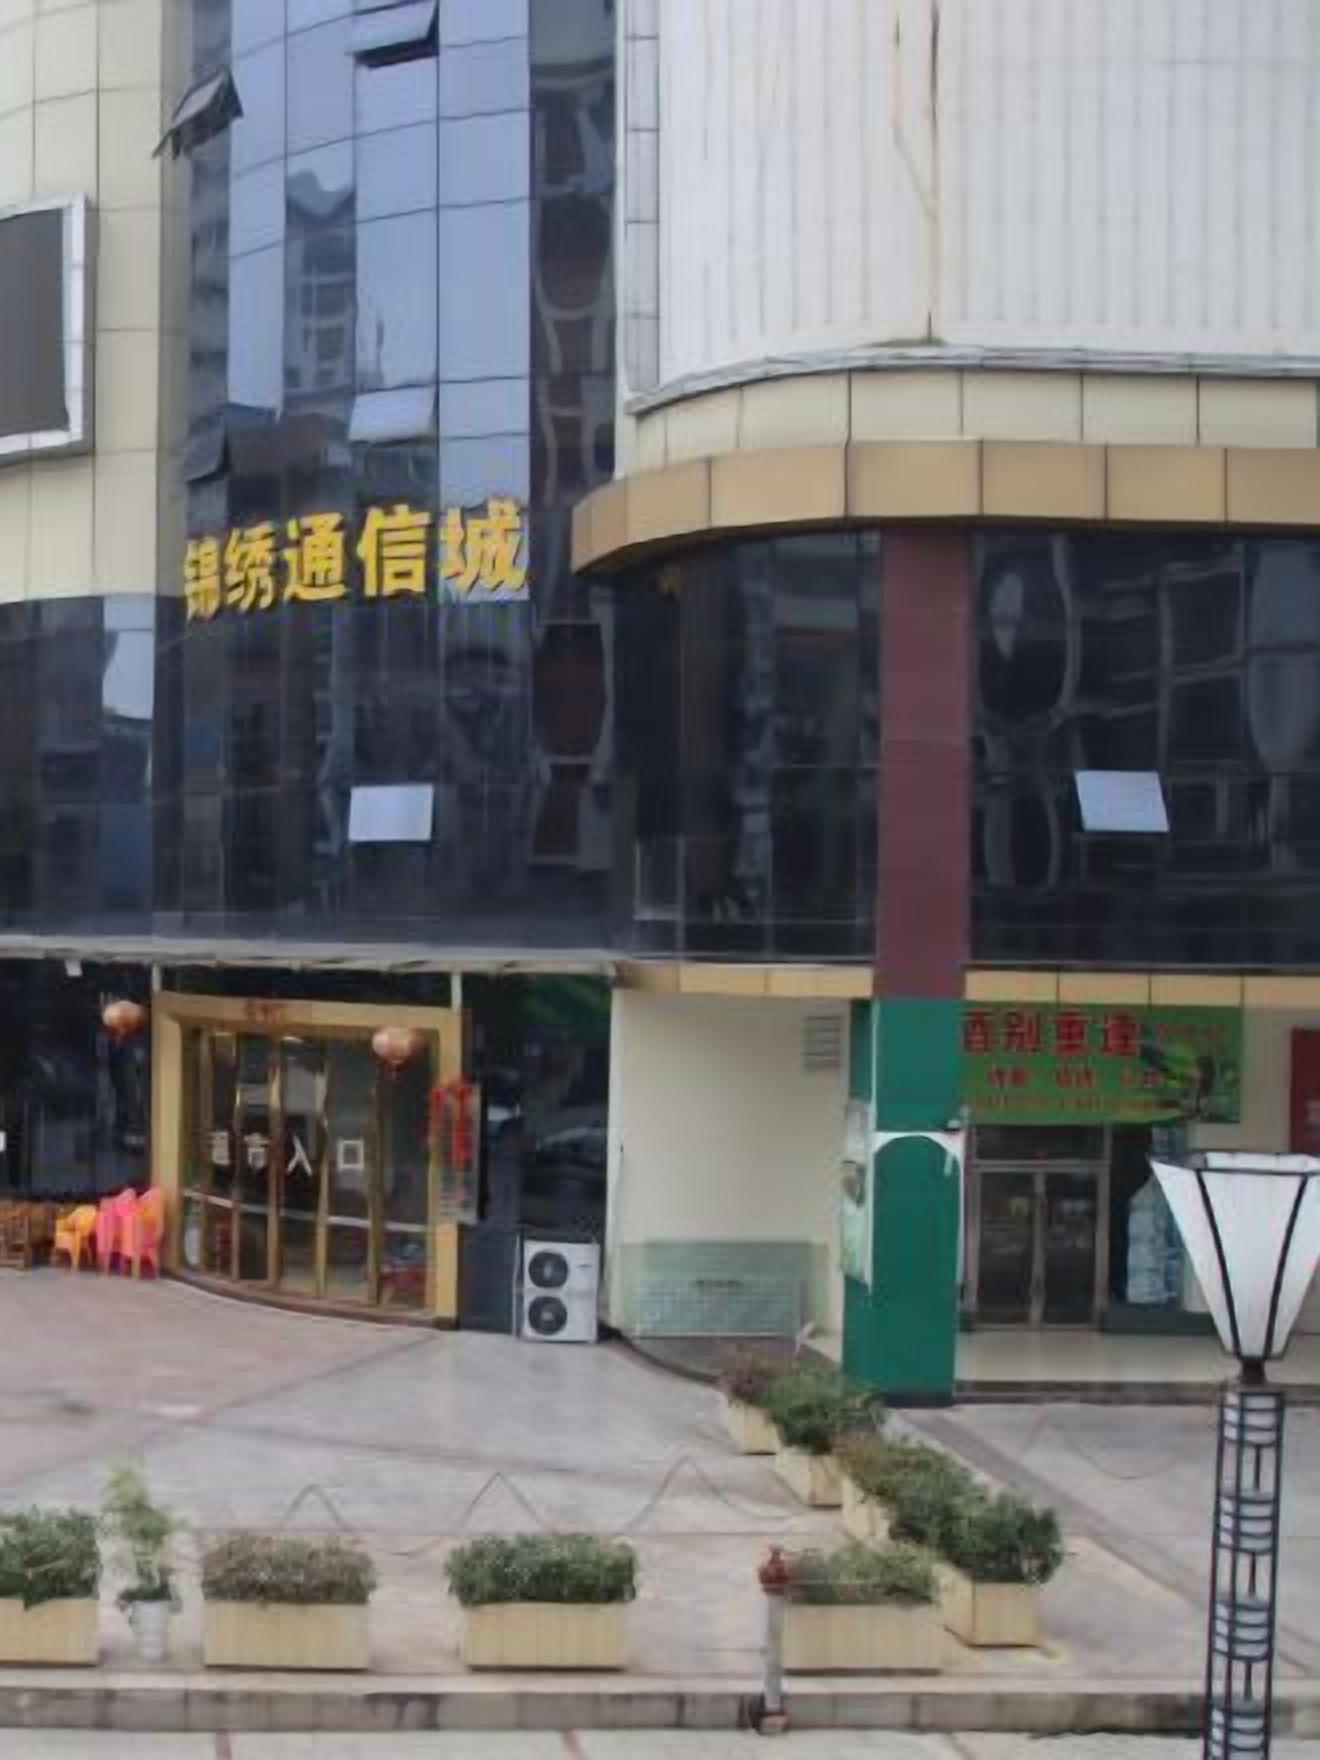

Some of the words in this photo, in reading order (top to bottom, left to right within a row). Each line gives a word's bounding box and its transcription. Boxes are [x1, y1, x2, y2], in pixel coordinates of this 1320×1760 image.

[183, 494, 528, 620] 锦绣通信城
